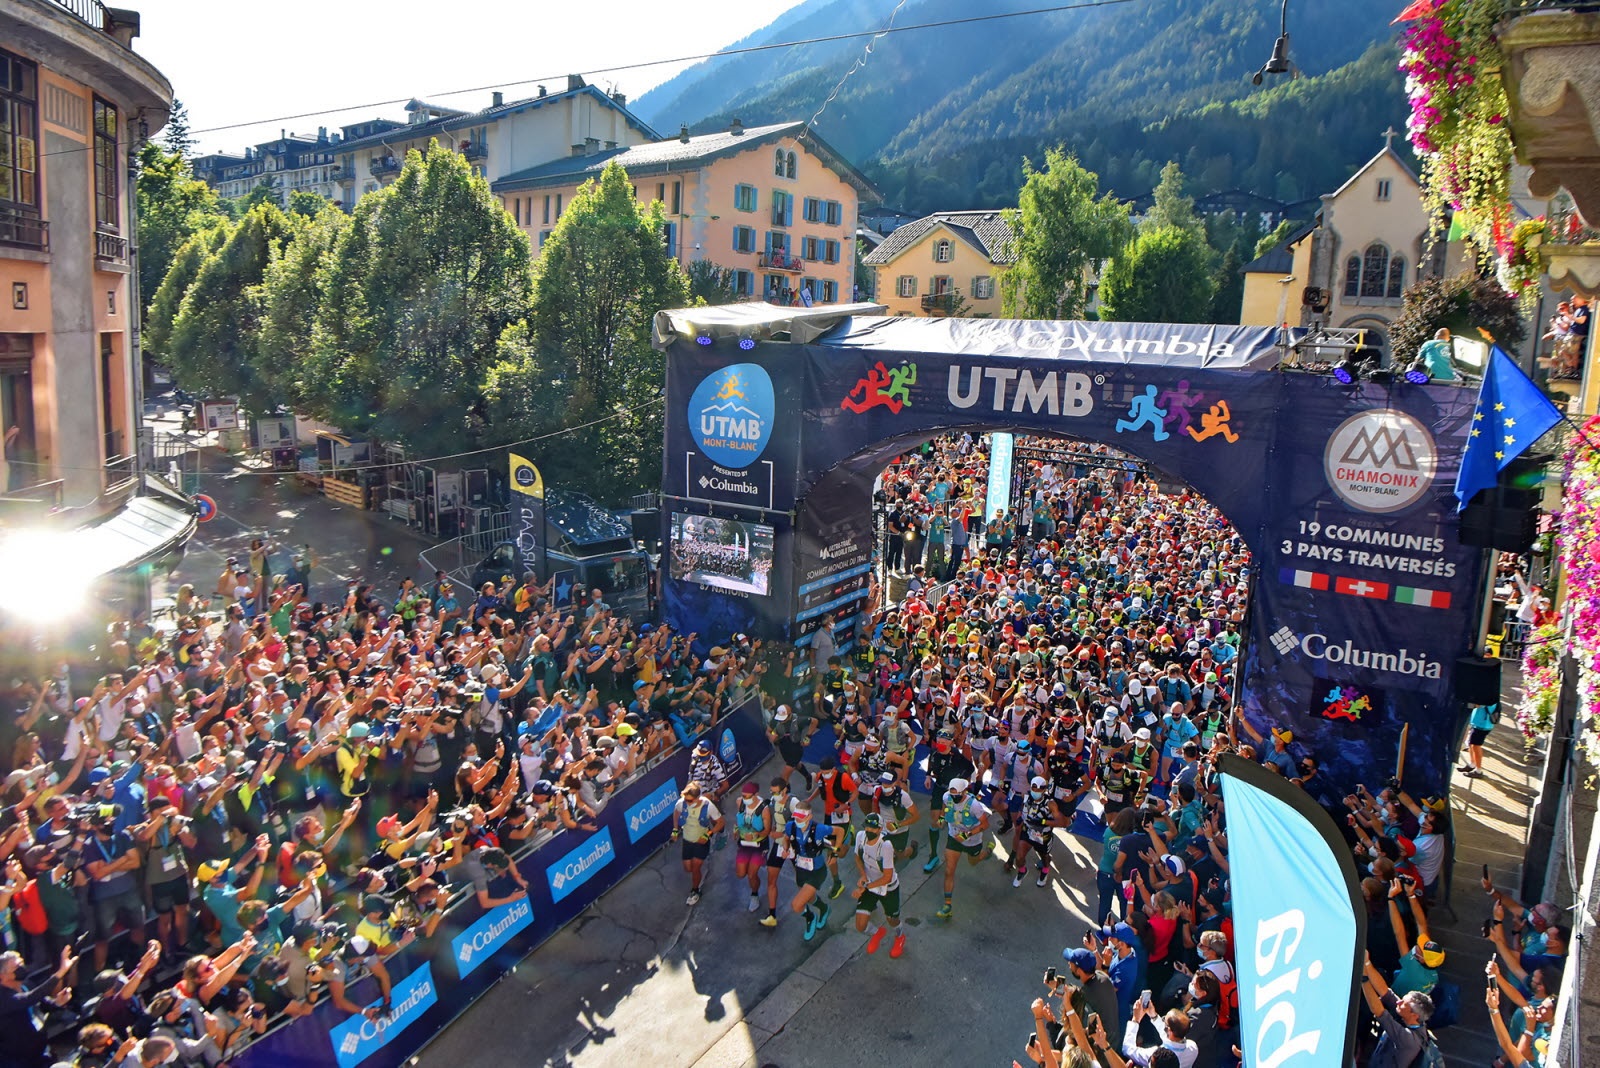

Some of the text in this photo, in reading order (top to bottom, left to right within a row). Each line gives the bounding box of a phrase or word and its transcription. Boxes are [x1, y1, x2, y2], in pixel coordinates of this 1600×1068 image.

[1016, 330, 1236, 358] Columbia
[703, 437, 758, 451] MONT-BLANC
[712, 464, 741, 477] PRESENTED
[1336, 467, 1420, 488] CHAMONIX
[709, 477, 759, 494] Columbia
[1299, 520, 1445, 553] 19 COMMUNES
[1280, 539, 1456, 578] 3 PAYS TRAVERSÉS
[806, 566, 828, 580] SOMMET
[711, 586, 749, 598] NATIONS
[1301, 633, 1441, 679] Columbia
[638, 790, 679, 824] Columbia
[564, 839, 612, 881] Columbia
[472, 902, 529, 952] Columbia
